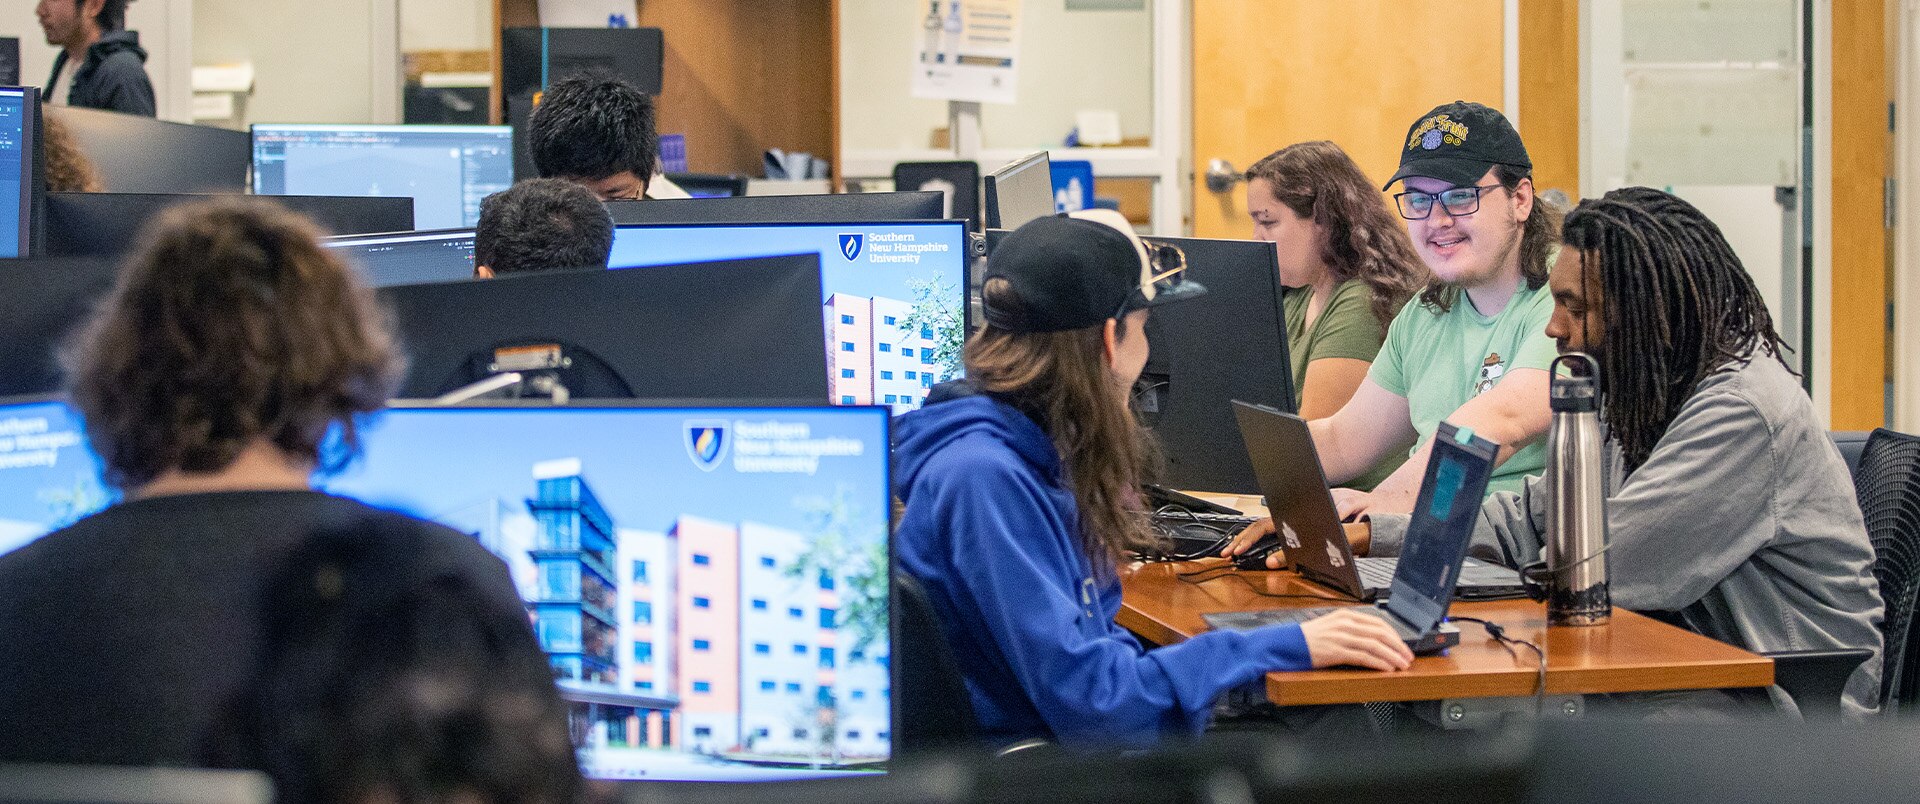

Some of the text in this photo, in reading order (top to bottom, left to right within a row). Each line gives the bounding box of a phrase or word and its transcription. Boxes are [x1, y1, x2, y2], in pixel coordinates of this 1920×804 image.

[869, 232, 915, 242] Southern
[869, 242, 948, 254] New Hampshire
[869, 253, 920, 264] University
